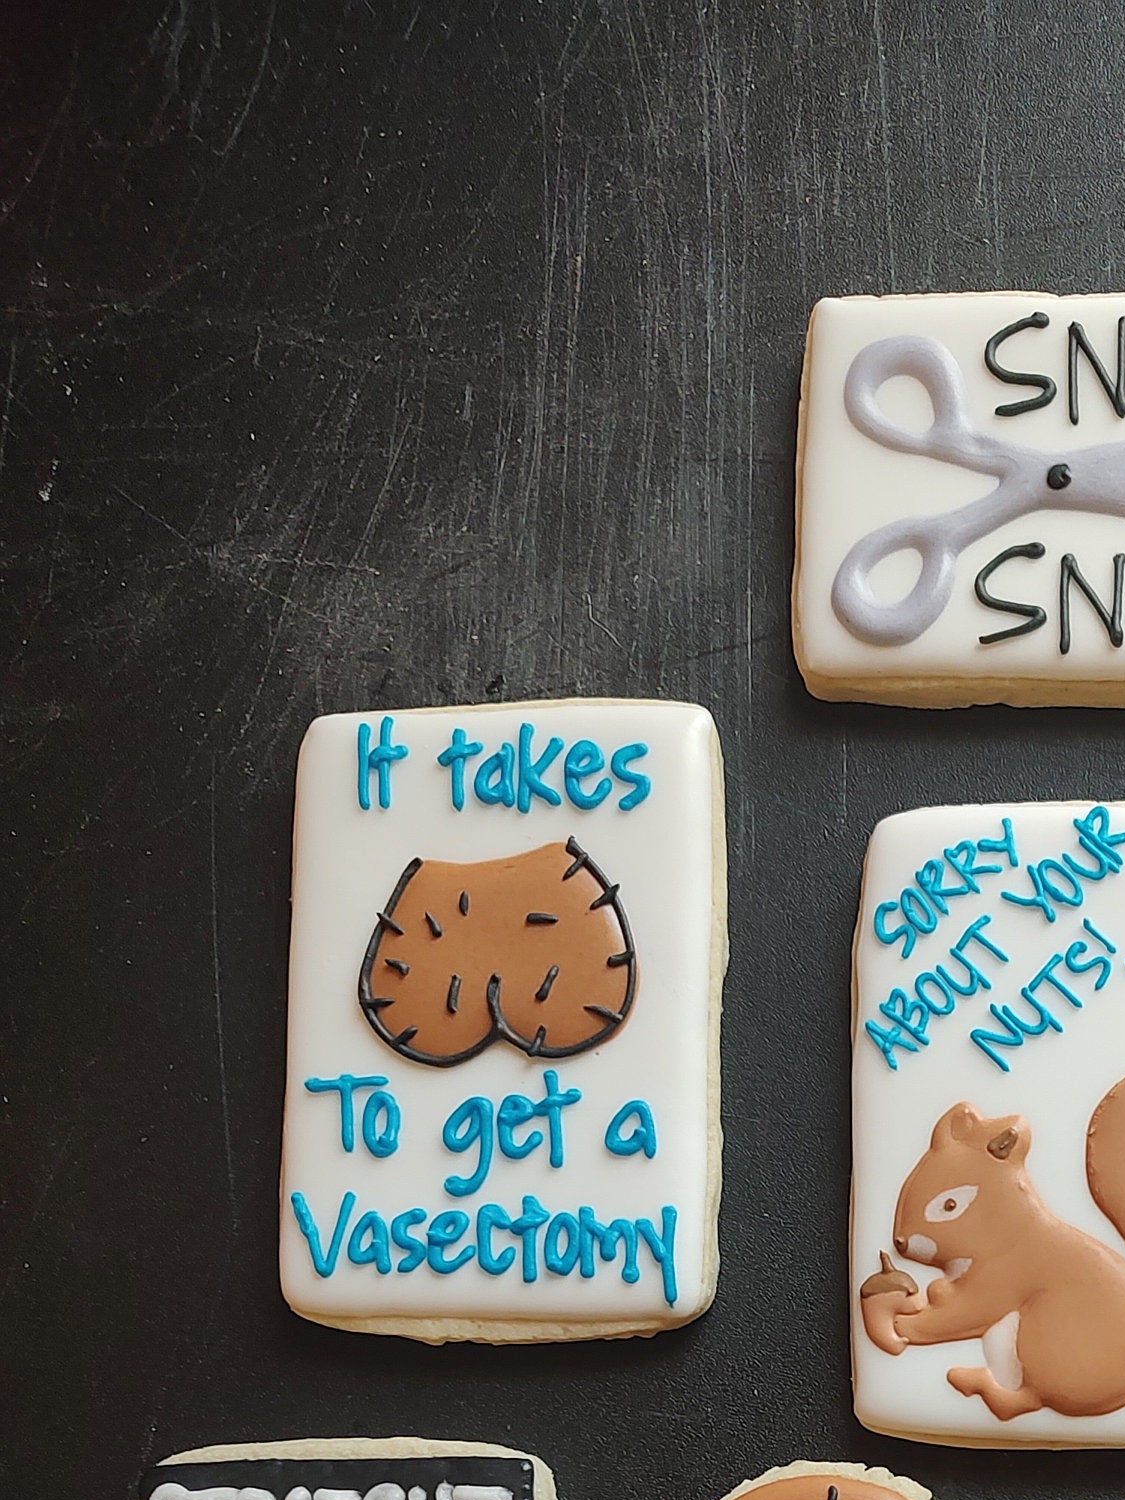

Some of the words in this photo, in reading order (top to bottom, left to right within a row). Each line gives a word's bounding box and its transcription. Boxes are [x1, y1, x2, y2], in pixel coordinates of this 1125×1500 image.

[356, 715, 409, 810] It
[437, 721, 653, 814] takes
[873, 817, 1019, 960] SORRY
[864, 914, 1010, 1071] ABOUT
[304, 1073, 401, 1159] To
[442, 1068, 582, 1198] get
[604, 1099, 657, 1160] a
[290, 1190, 681, 1309] Vasectomy
